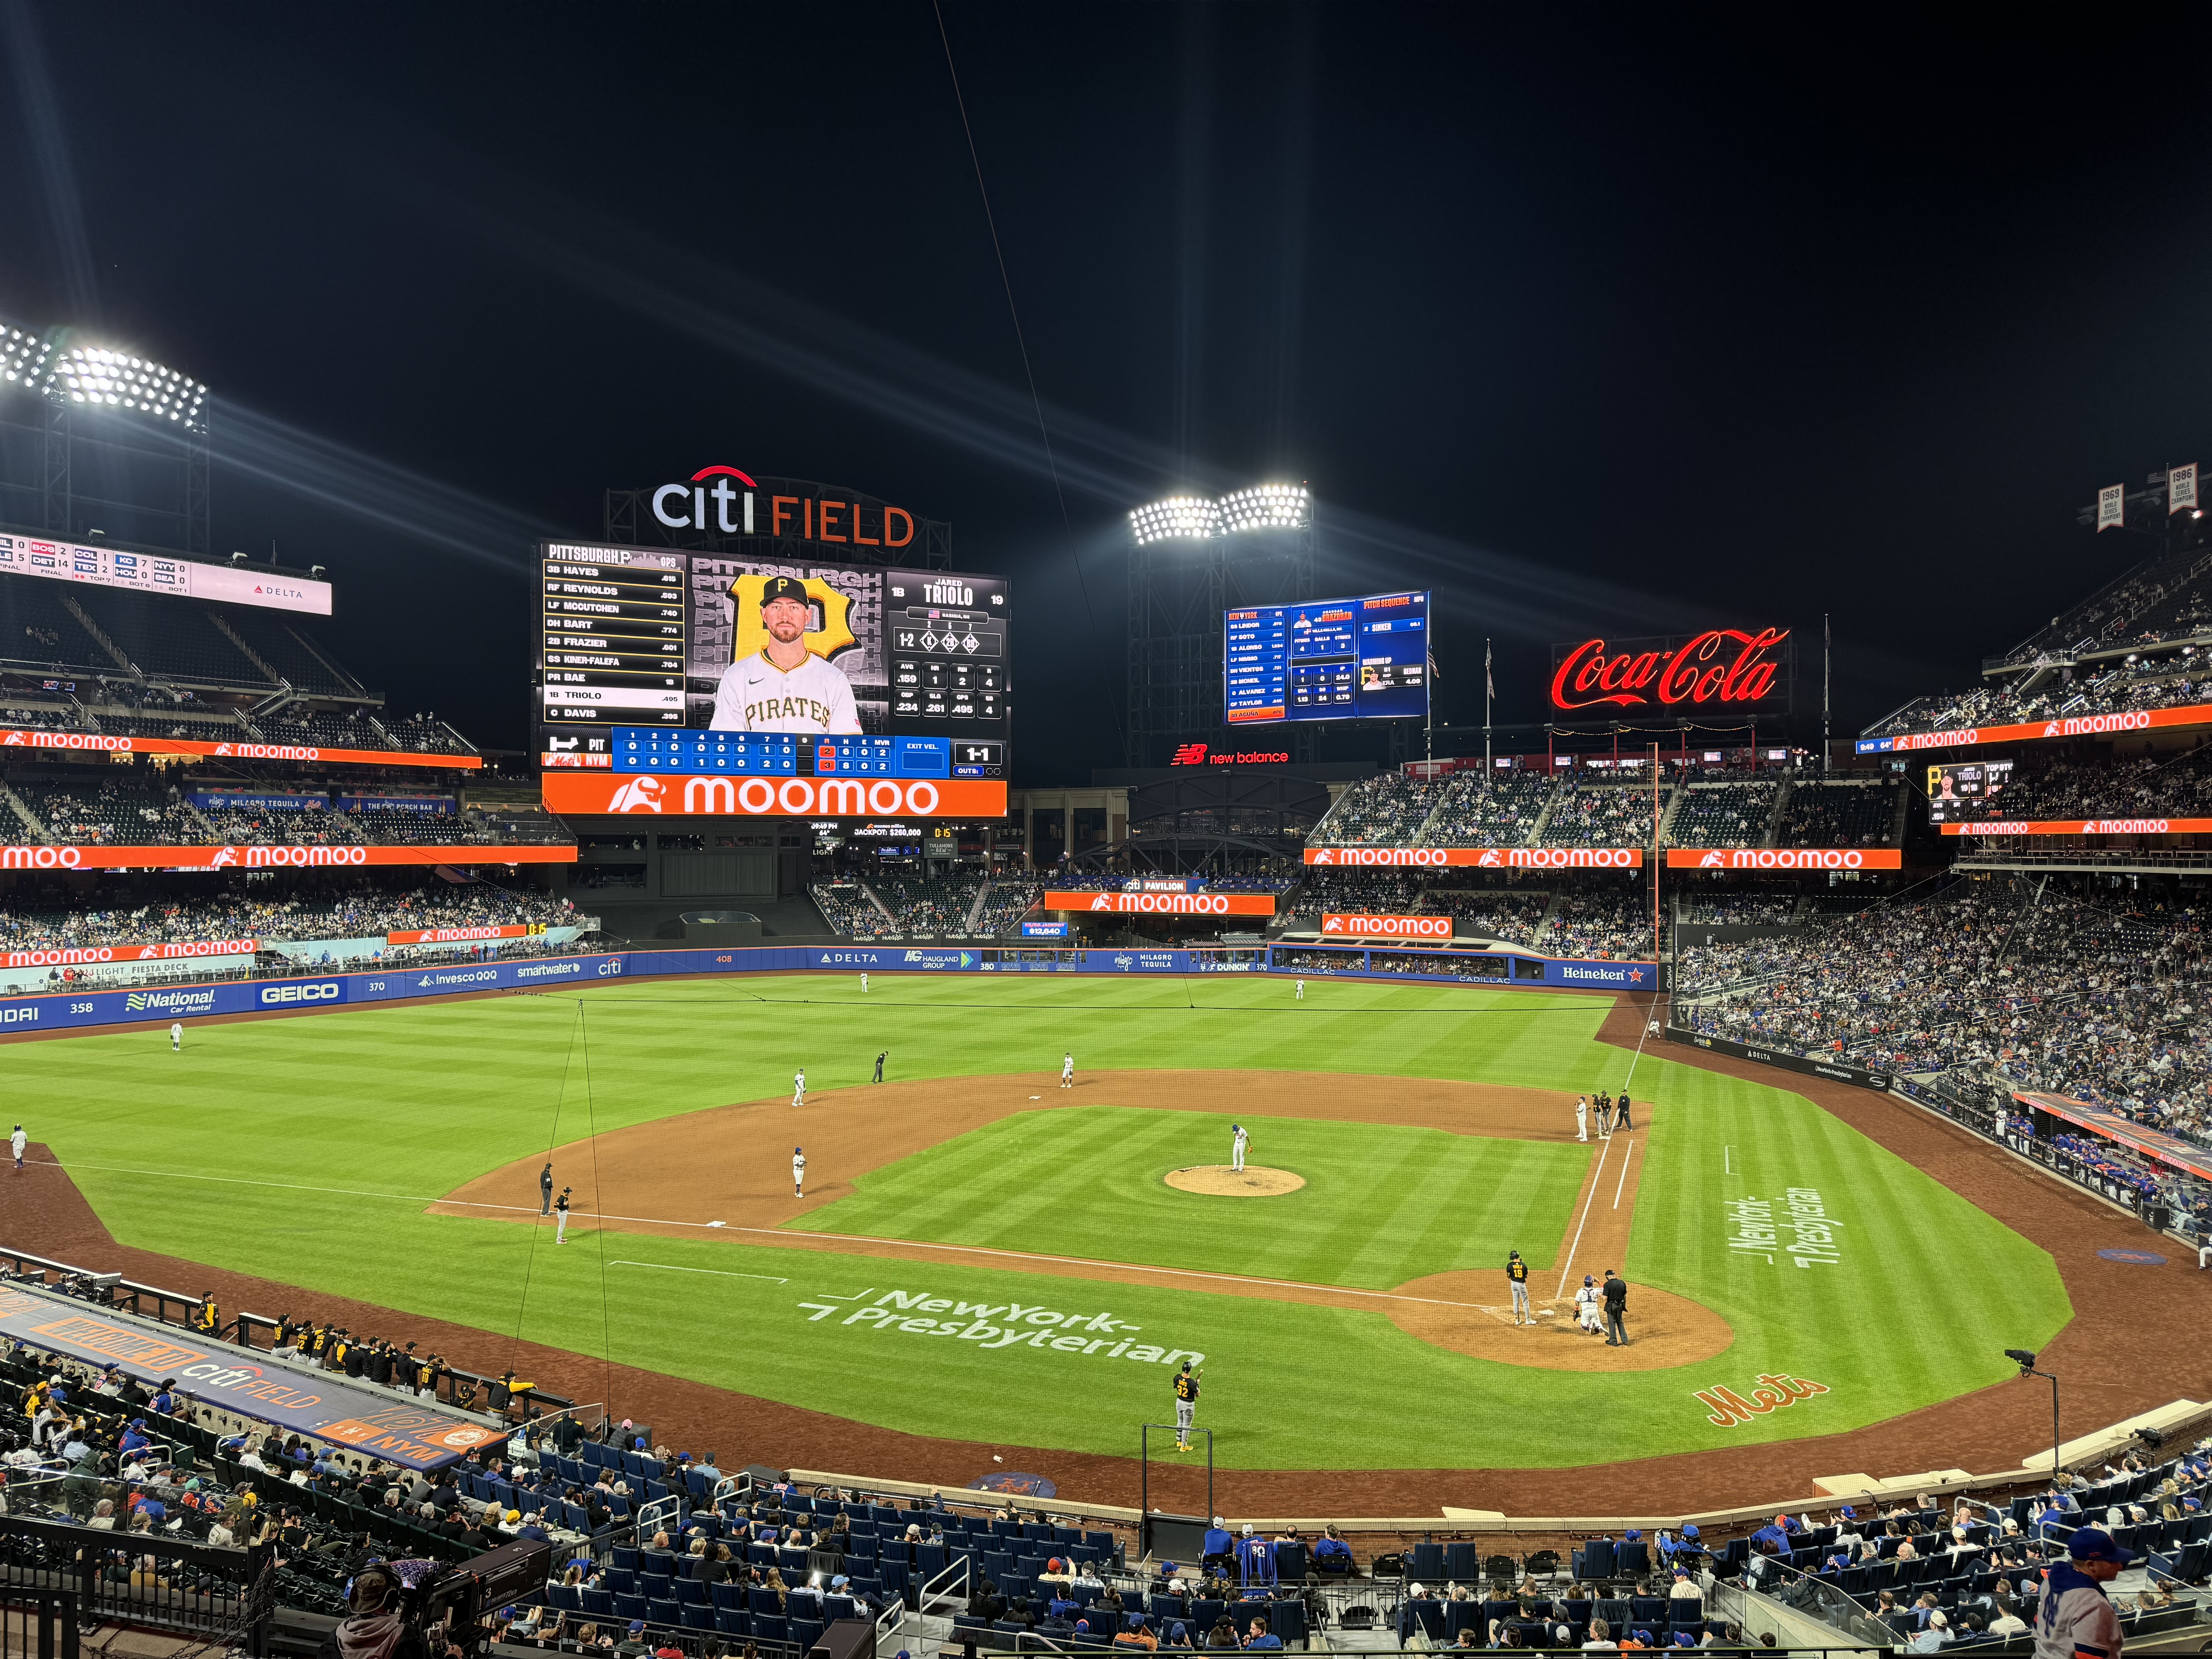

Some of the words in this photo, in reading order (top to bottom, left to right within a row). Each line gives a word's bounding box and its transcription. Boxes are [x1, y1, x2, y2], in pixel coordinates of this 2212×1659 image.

[2173, 469, 2192, 482] 1986
[2102, 488, 2119, 501] 1969
[2176, 488, 2190, 496] SERIES
[2171, 494, 2194, 504] CHAMPIONS
[653, 478, 754, 534] citi
[773, 495, 914, 546] FIELD
[2104, 507, 2117, 515] SERIES
[2100, 513, 2121, 522] CHAMPIONS
[33, 544, 55, 553] BOS
[33, 557, 54, 565] DET
[119, 557, 133, 565] KC
[550, 544, 619, 564] PITTSBURGH
[660, 557, 676, 568] OPS
[115, 568, 136, 577] HOU
[155, 562, 174, 571] NYY
[547, 566, 560, 574] 3B
[563, 566, 599, 576] HAYES
[154, 574, 174, 583] SEA
[935, 578, 962, 586] JARED
[266, 587, 302, 598] DELTA
[563, 584, 618, 596] REYNOLDS
[892, 587, 904, 597] 1B
[924, 584, 973, 606] TRIOLO
[991, 596, 1003, 605] 19
[564, 602, 619, 613] MCCUTCHEN
[1381, 597, 1410, 607] SEQUENCE
[564, 620, 592, 629] BART
[1372, 623, 1391, 632] SINKER
[564, 638, 607, 647] FRAZIER
[900, 633, 914, 647] 1-2
[564, 656, 619, 666] KINER-FALEFA
[1551, 627, 1790, 709] Coca-Cola
[548, 673, 560, 681] PR
[898, 674, 917, 683] .159
[565, 692, 601, 700] TRIOLO
[564, 709, 596, 718] DAVIS
[745, 696, 831, 730] PIRATES
[896, 702, 918, 711] .234
[926, 704, 944, 713] .261
[952, 705, 973, 714] .495
[2065, 712, 2150, 734] moomoo
[1913, 730, 1977, 749] moomoo
[33, 732, 132, 751] moomoo
[238, 743, 318, 760] moomoo
[589, 739, 605, 750] PIT
[967, 748, 989, 761] 1-1
[586, 754, 608, 766] NYM
[1210, 753, 1234, 764] new
[1237, 751, 1288, 763] balance
[1958, 771, 1981, 781] TRIOLO
[685, 777, 939, 814] moomoo
[1973, 823, 2027, 833] moomoo
[2100, 820, 2168, 833] moomoo
[247, 847, 366, 865] moomoo
[1341, 849, 1447, 866] moomoo
[1510, 849, 1632, 867] moomoo
[1733, 850, 1862, 868] moomoo
[1145, 882, 1183, 891] PAVILION
[1119, 893, 1228, 913] moomoo
[1350, 917, 1448, 934] moomoo
[437, 926, 501, 941] moomoo
[9, 948, 112, 967] moomoo
[165, 939, 253, 957] moomoo
[836, 954, 877, 963] DELTA
[904, 950, 922, 961] HG
[96, 967, 124, 975] LIGHT
[132, 965, 162, 974] FIESTA
[164, 963, 188, 972] DECK
[518, 963, 572, 977] smartwater
[1563, 967, 1624, 981] Heineken
[436, 973, 475, 985] Invesco
[477, 970, 497, 981] QQQ
[1459, 976, 1510, 984] CADILLAC
[369, 982, 385, 991] 370
[262, 984, 338, 1003] GEICO
[70, 1003, 93, 1013] 358
[186, 1003, 211, 1012] Rental
[1753, 1051, 1770, 1061] DELTA
[1724, 1196, 1777, 1250] NewYork-
[1775, 1188, 1844, 1256] Presbyterian
[1513, 1269, 1522, 1278] 19
[873, 1290, 1142, 1333] NewYork-
[46, 1322, 161, 1359] WELCOME
[842, 1307, 1206, 1364] Presbyterian
[239, 1379, 321, 1408] FIELD
[1177, 1385, 1188, 1398] 32
[1692, 1373, 1830, 1427] Mets
[371, 1436, 444, 1462] NYM
[486, 1588, 491, 1598] 3
